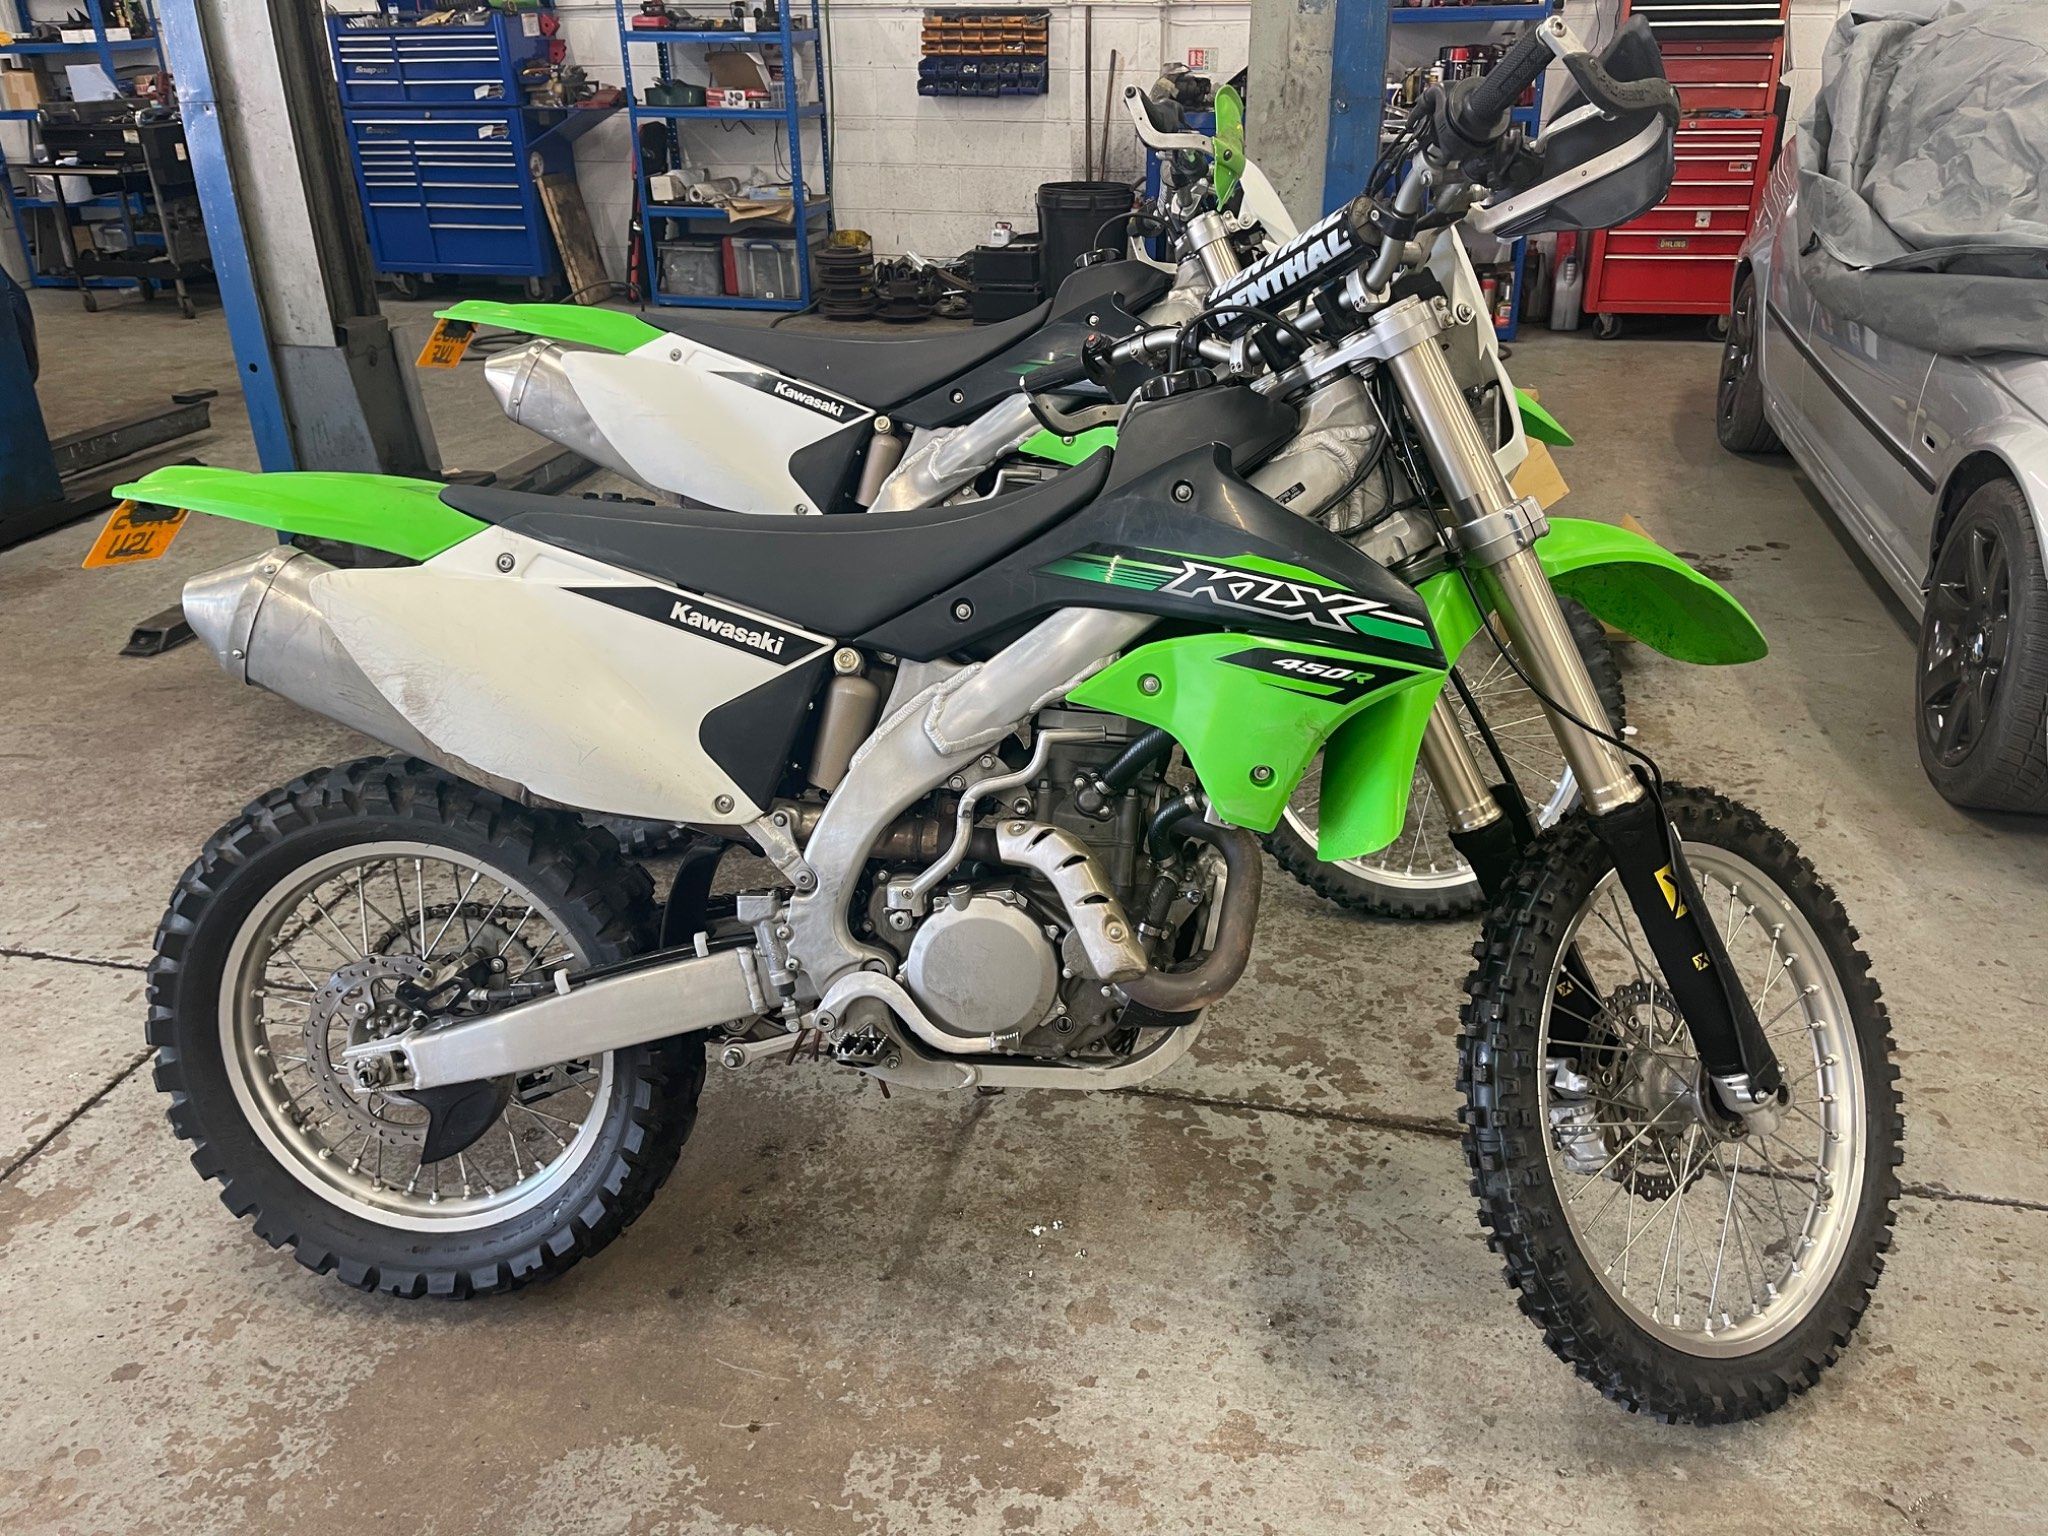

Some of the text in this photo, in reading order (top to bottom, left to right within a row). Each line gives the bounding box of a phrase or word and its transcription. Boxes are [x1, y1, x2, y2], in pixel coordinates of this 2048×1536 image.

[1213, 228, 1352, 327] RENTHAL
[774, 381, 845, 417] Kawasaki
[1158, 560, 1390, 635] KLX
[669, 601, 785, 655] Kawasaki
[1272, 658, 1376, 685] 450R
